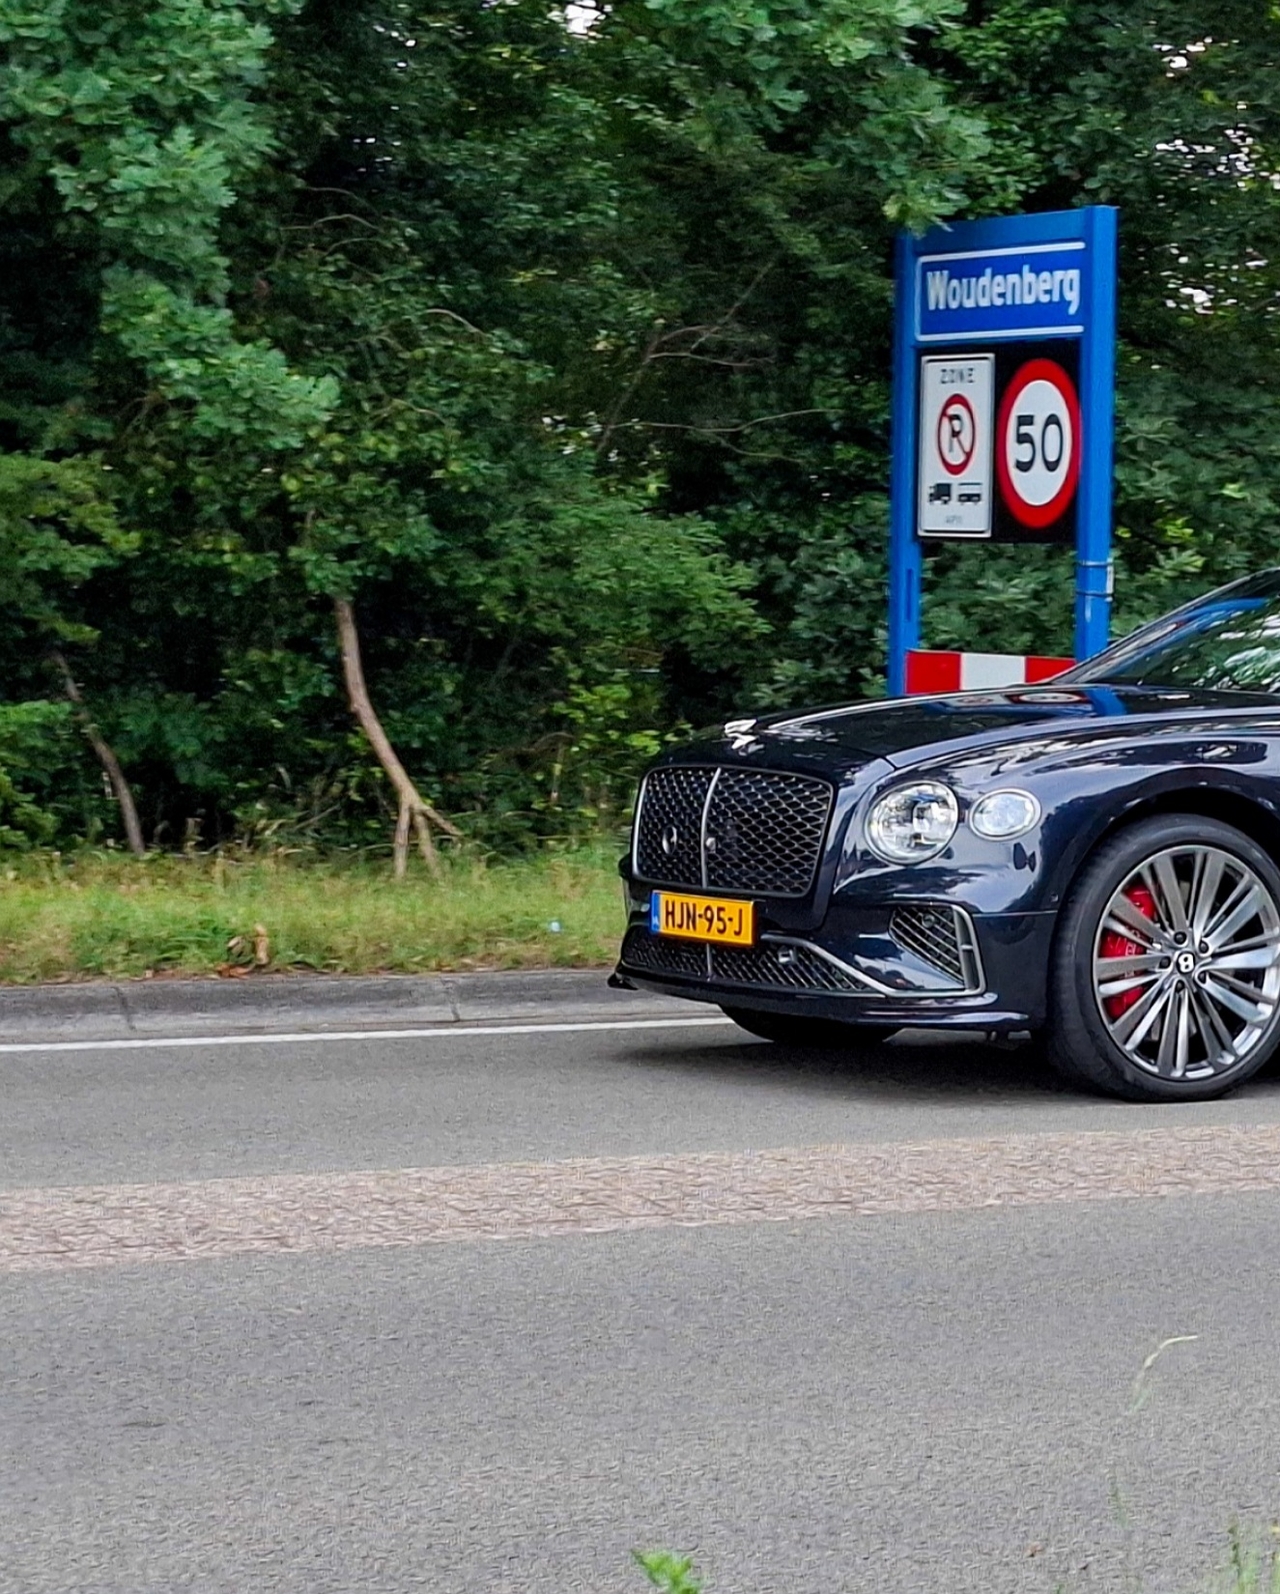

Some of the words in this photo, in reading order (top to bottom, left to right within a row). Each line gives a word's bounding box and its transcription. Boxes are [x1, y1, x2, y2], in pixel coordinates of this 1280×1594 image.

[926, 264, 1081, 316] Woudenberg
[1015, 413, 1064, 473] 50
[665, 899, 743, 937] HJN-95-J
